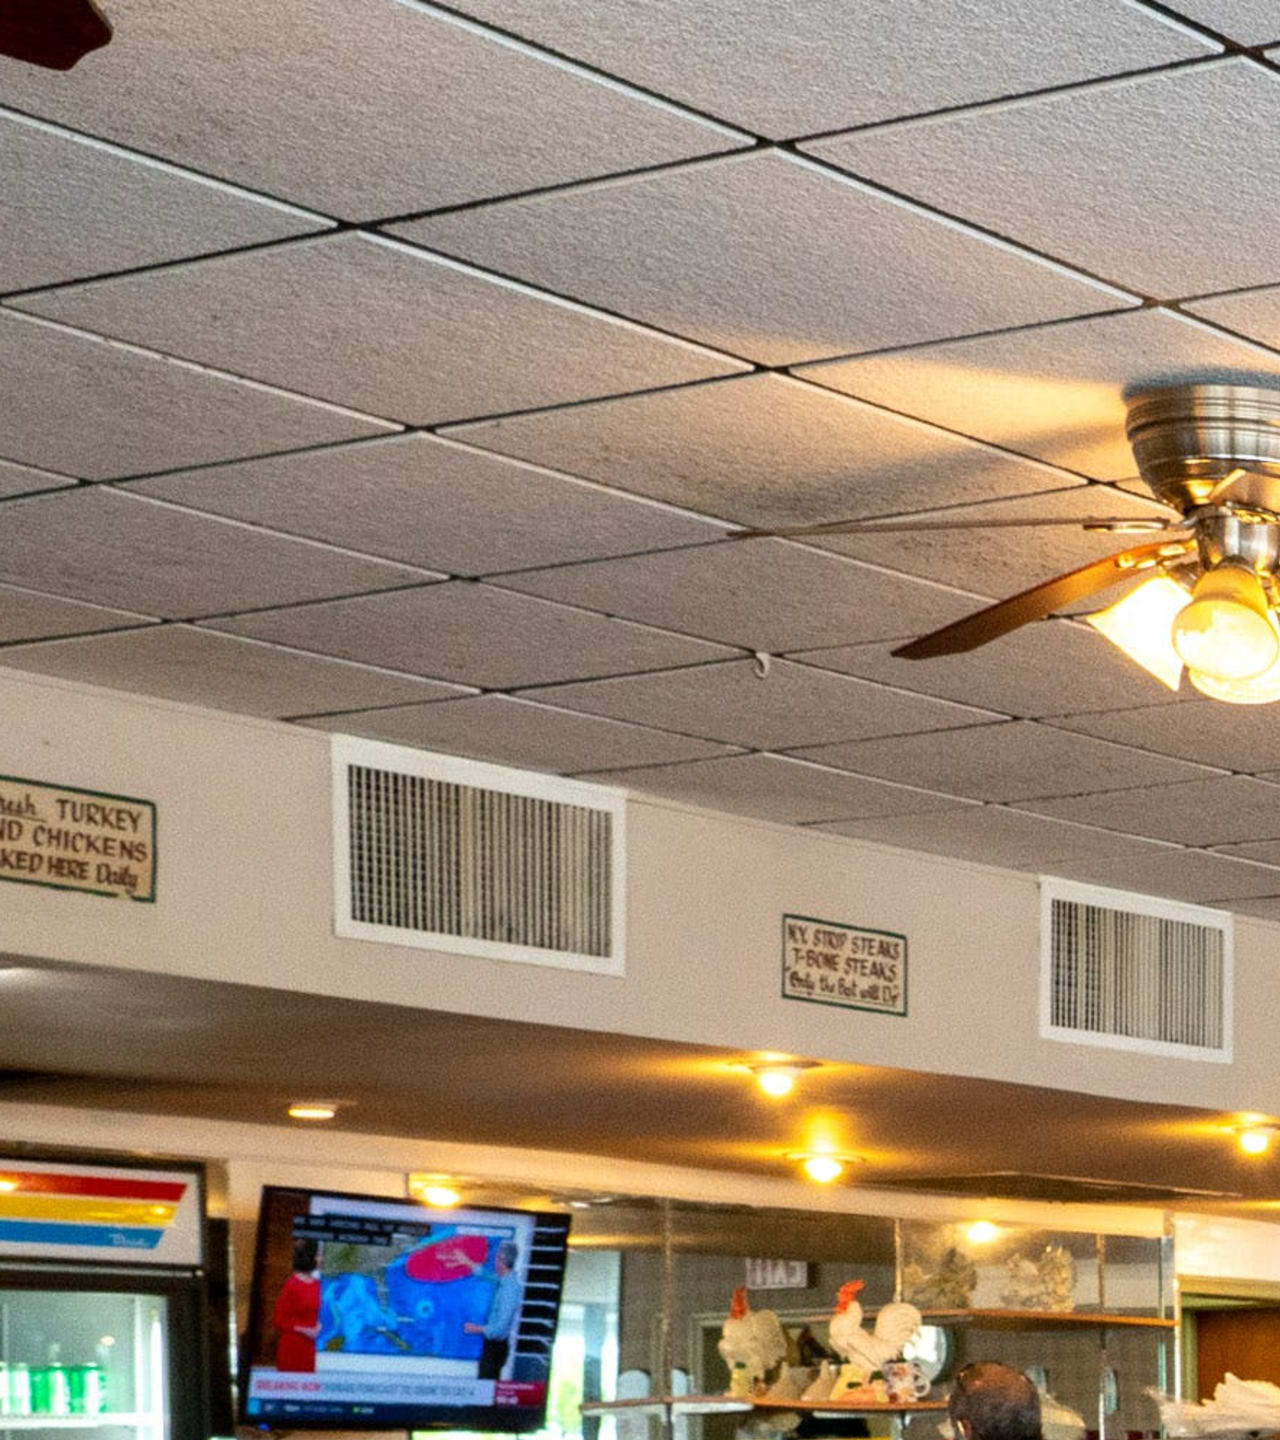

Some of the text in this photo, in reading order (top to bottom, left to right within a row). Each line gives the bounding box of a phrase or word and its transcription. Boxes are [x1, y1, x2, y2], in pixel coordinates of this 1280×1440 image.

[56, 798, 141, 833] TURKEY
[33, 825, 148, 863] CHICKENS
[48, 856, 89, 880] HERE
[97, 862, 138, 895] Daily
[792, 948, 898, 983] T-BONE STEAKS
[851, 936, 900, 961] STEAKS
